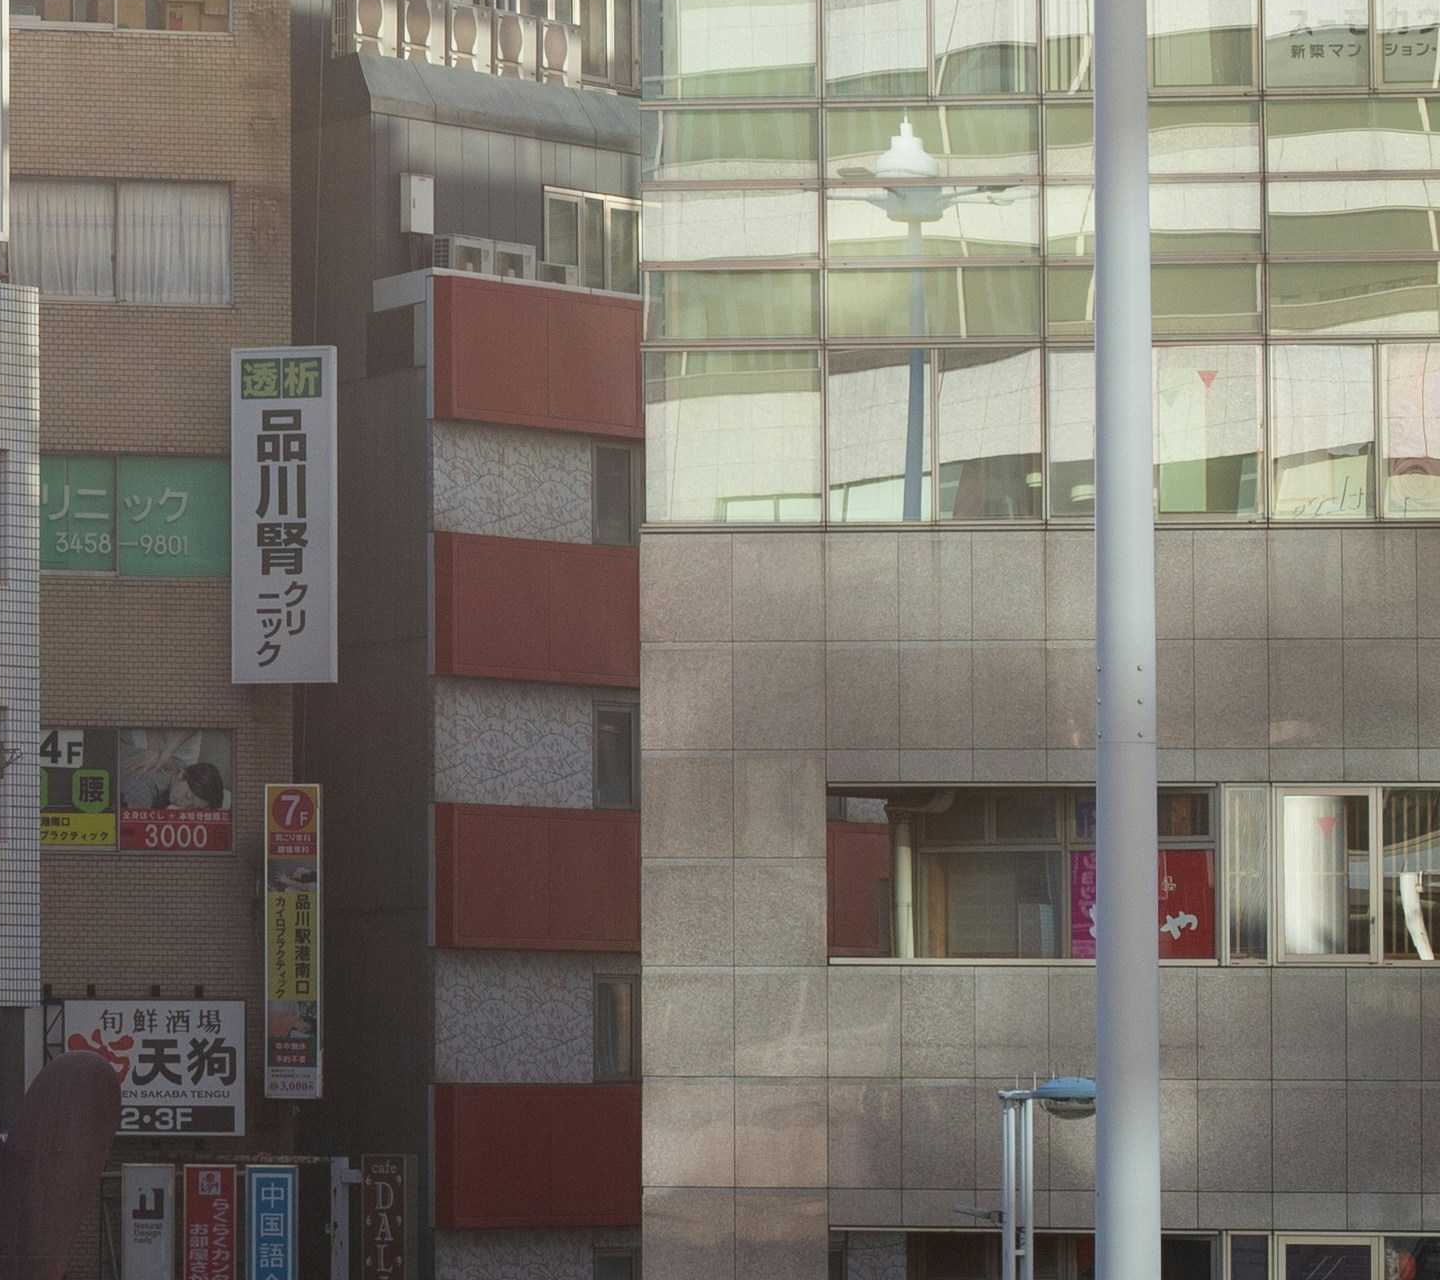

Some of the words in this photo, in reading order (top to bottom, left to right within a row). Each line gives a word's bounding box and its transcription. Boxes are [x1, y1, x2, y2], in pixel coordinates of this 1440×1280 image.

[241, 360, 322, 398] 透析
[281, 789, 308, 827] 7F
[99, 1009, 223, 1035] 旬鮮酒場
[131, 1036, 237, 1087] 天狗
[138, 1090, 186, 1100] SAKABA
[188, 1090, 230, 1100] TENGU
[370, 1161, 398, 1175] cafe
[133, 1221, 163, 1231] Natural
[133, 1230, 162, 1238] Design
